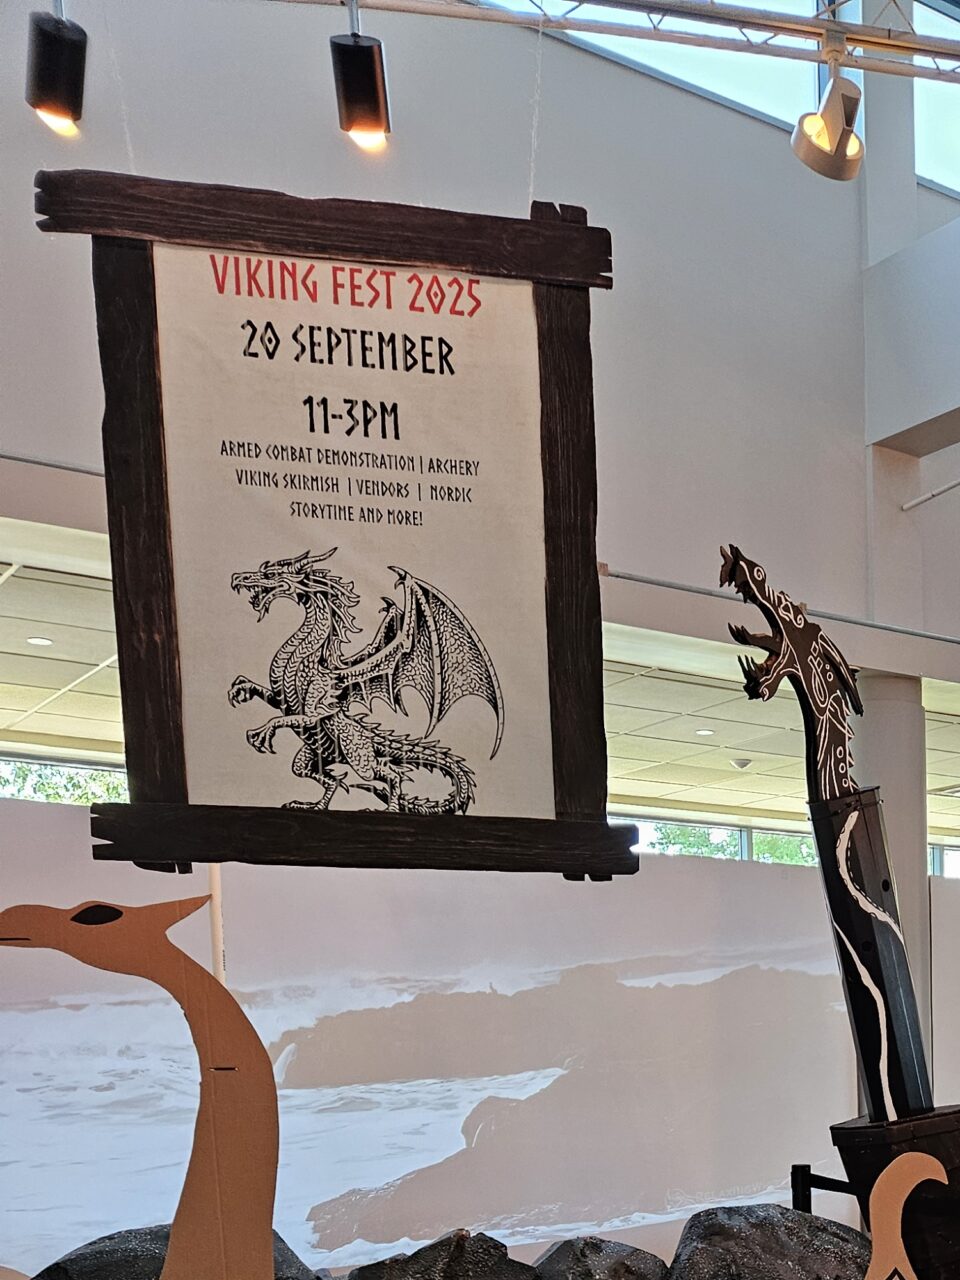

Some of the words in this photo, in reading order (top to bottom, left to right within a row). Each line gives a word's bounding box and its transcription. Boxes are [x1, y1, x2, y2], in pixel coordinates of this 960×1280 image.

[209, 254, 318, 303] VIKING
[332, 266, 396, 309] FEST
[407, 273, 482, 318] 2025
[241, 319, 280, 360] 20
[291, 323, 456, 376] SEPTEMBER
[302, 395, 401, 440] 11-3PM
[220, 440, 262, 459] ARMED
[265, 444, 313, 463] COMBAT
[317, 448, 415, 472] DEMONSTRATION
[428, 458, 480, 477] ARCHERY
[235, 468, 279, 488] VIKING
[282, 473, 340, 493] SKIRMISH
[356, 479, 410, 498] VENDORS
[430, 485, 473, 503] NORDIC
[289, 501, 355, 522] STORYTIME
[359, 506, 384, 524] AND
[387, 508, 424, 527] MORE!
